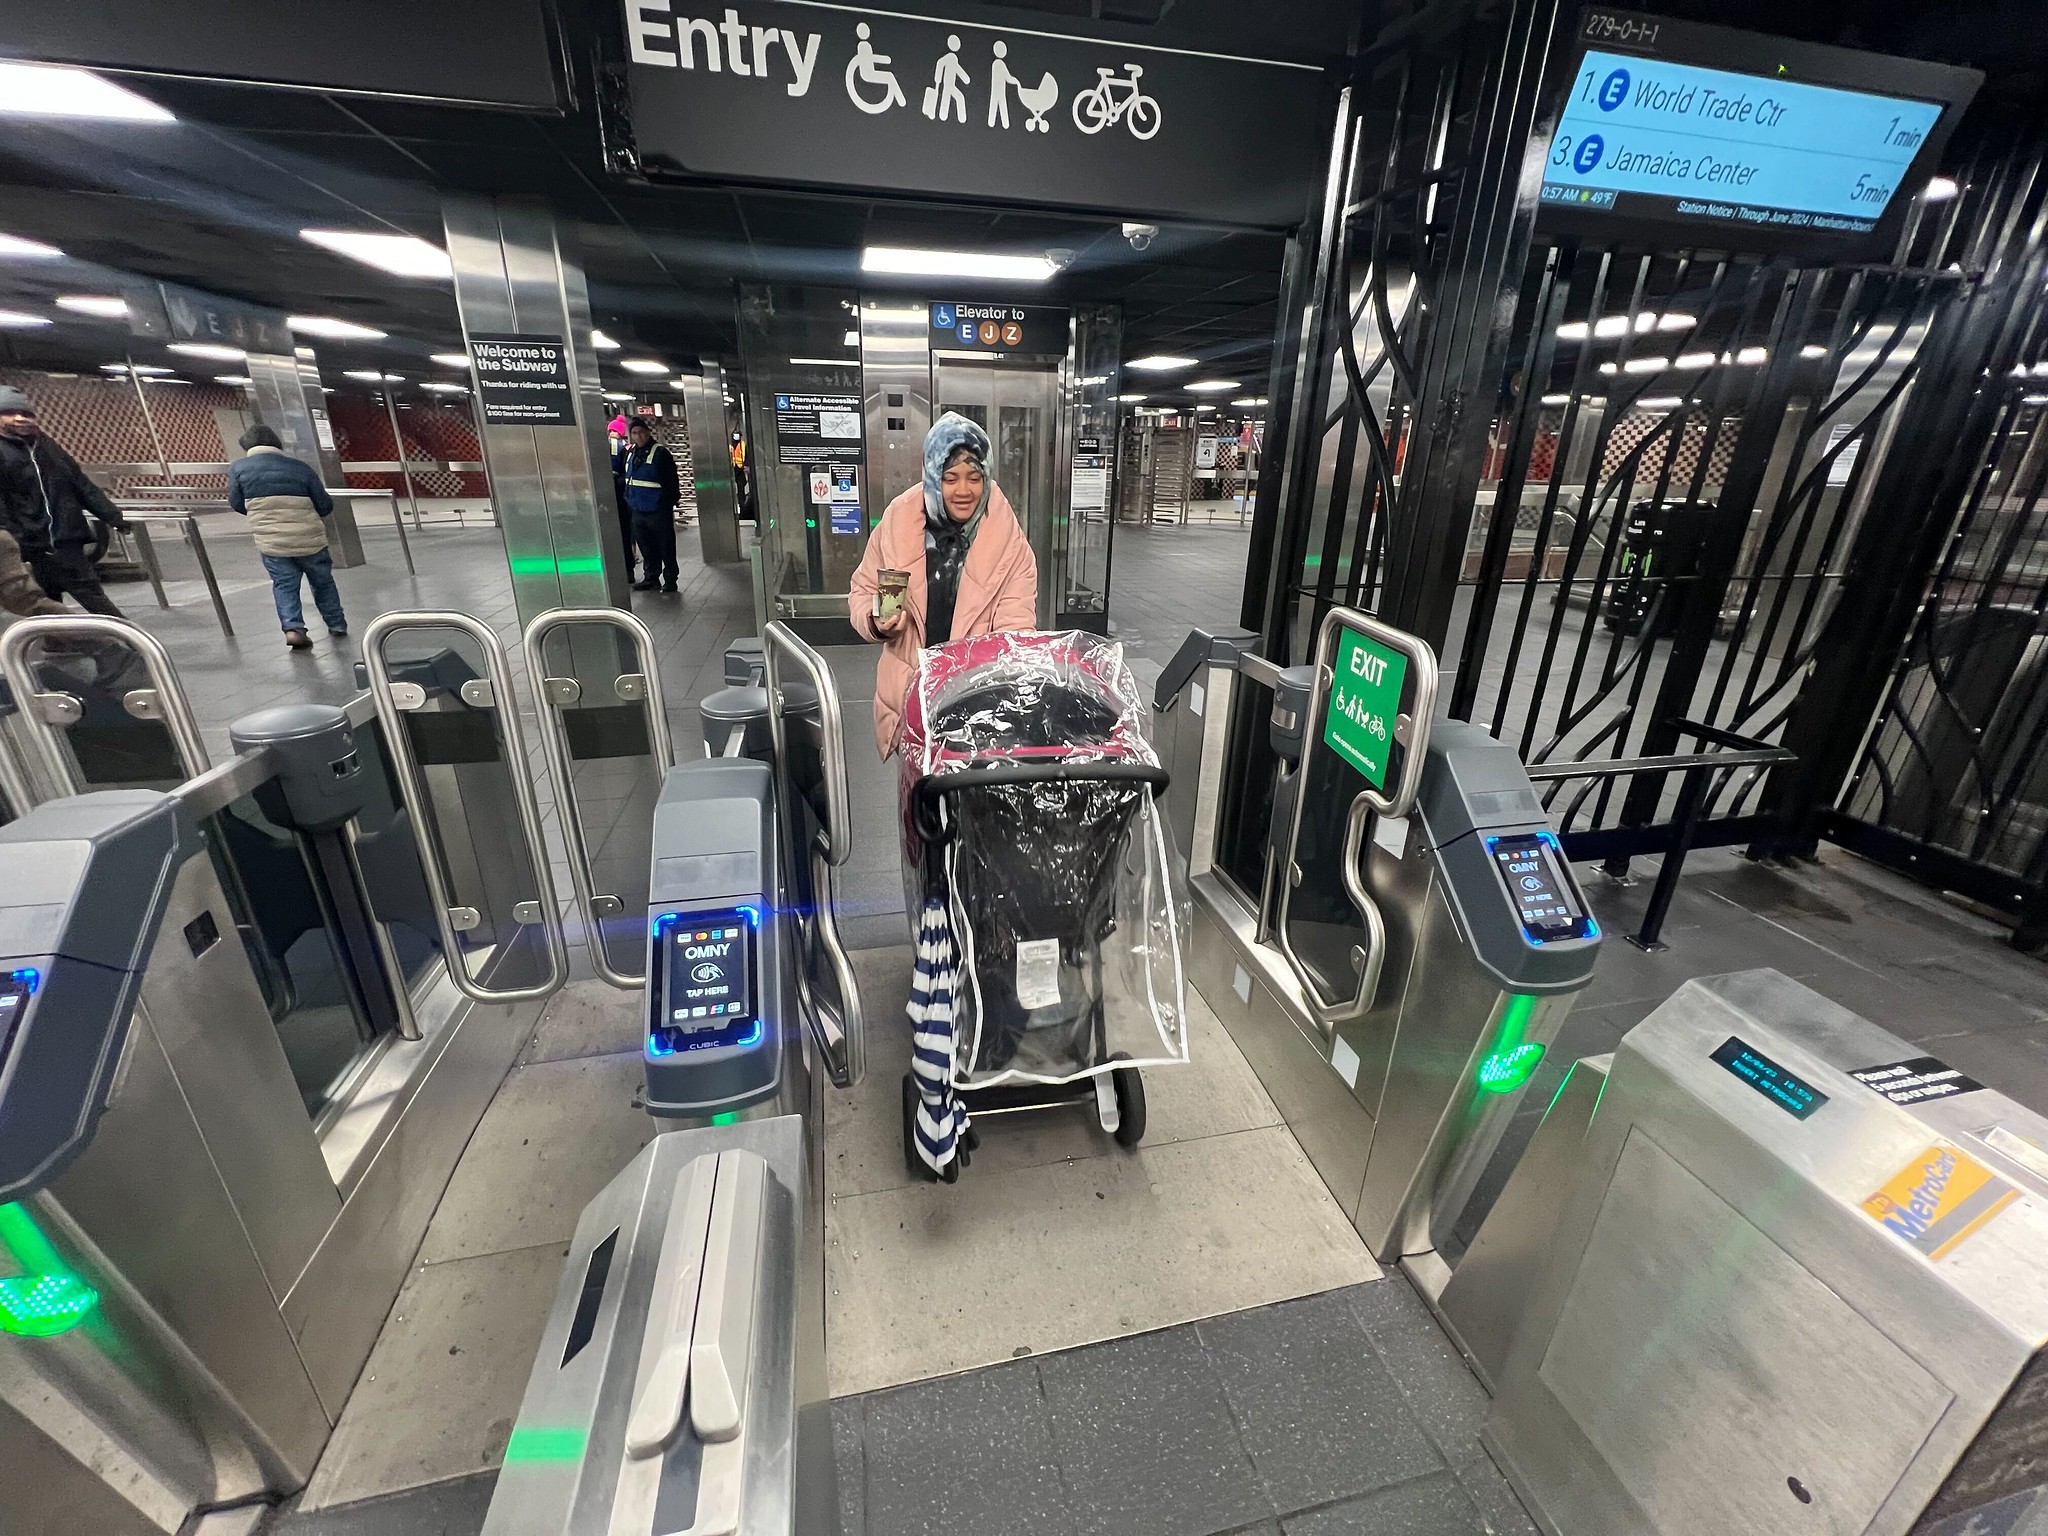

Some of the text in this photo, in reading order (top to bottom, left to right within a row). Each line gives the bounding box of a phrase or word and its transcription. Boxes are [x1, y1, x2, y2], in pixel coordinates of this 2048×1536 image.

[1585, 14, 1660, 43] 279-0-1-1
[625, 0, 822, 97] Entry
[1581, 70, 1596, 103] 1.
[1605, 77, 1624, 103] E
[1634, 79, 1698, 115] World
[1698, 89, 1752, 123] Trade
[1755, 98, 1788, 127] Ctr
[1892, 128, 1922, 148] min
[1553, 135, 1572, 167] 3.
[1579, 142, 1598, 166] E
[1606, 145, 1692, 178] Jamaica
[1695, 155, 1759, 186] Center
[1562, 189, 1579, 201] AM
[1677, 200, 1707, 214] Station
[1706, 204, 1733, 217] Notice
[1738, 207, 1770, 223] Through
[1769, 211, 1789, 224] June
[1788, 213, 1809, 225] 2024
[956, 304, 1025, 320] Elevator to
[206, 312, 222, 334] E
[962, 324, 1017, 340] E J Z
[473, 344, 556, 359] Welcome to
[477, 358, 557, 374] the Subway
[481, 380, 508, 388] Thanks
[520, 381, 541, 390] riding
[812, 404, 852, 412] Information
[822, 397, 859, 405] Accessible
[1350, 646, 1388, 687] EXIT
[1509, 861, 1540, 873] OMNY
[684, 943, 731, 960] OMNY
[686, 985, 729, 998] TAP HERE
[689, 1040, 720, 1050] CUBIC
[1870, 1083, 1885, 1092] 5
[1881, 1151, 1958, 1243] MetroCard
